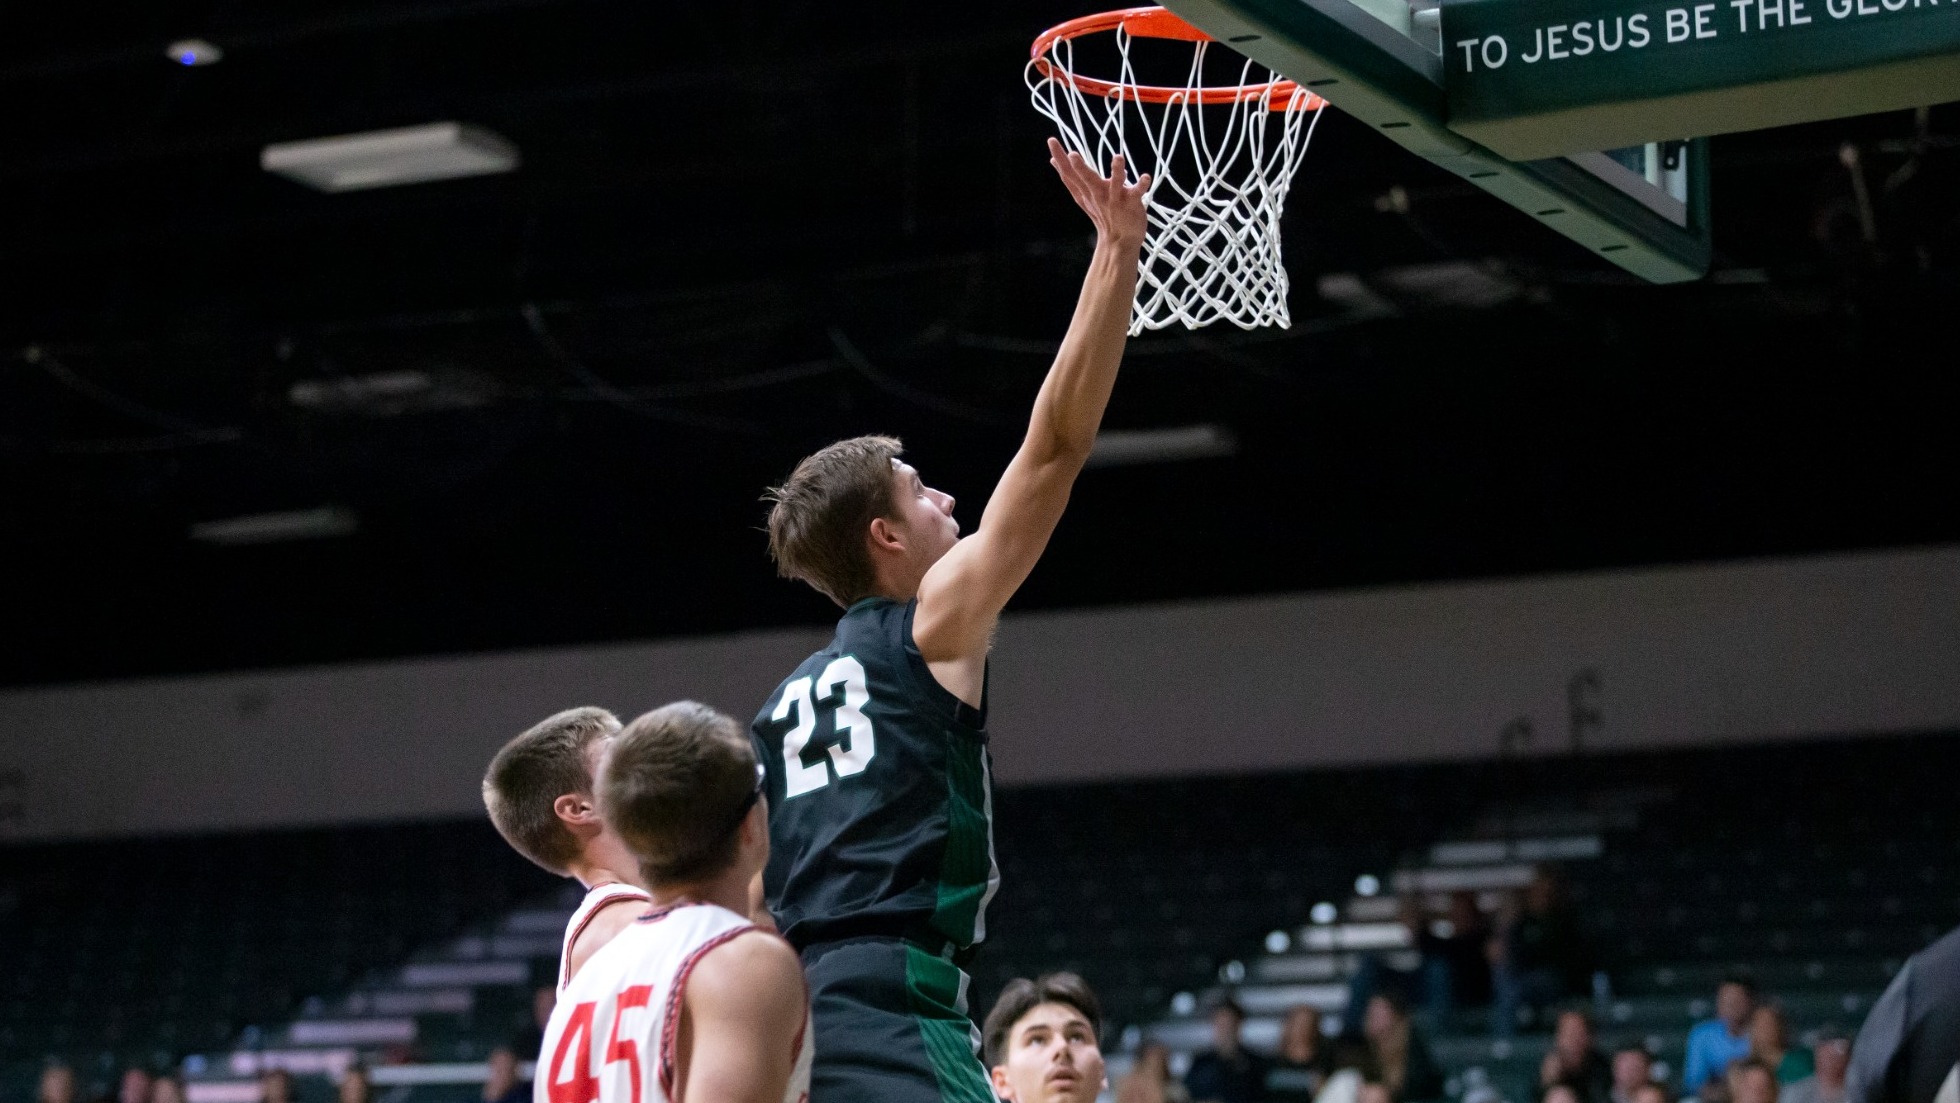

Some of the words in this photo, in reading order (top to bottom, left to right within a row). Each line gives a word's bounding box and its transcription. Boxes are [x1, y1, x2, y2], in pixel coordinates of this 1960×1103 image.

[1456, 35, 1508, 72] TO
[1521, 13, 1650, 63] JESUS
[1665, 3, 1717, 43] BE
[1730, 0, 1812, 33] THE
[771, 654, 877, 799] 23
[547, 984, 654, 1103] 45
